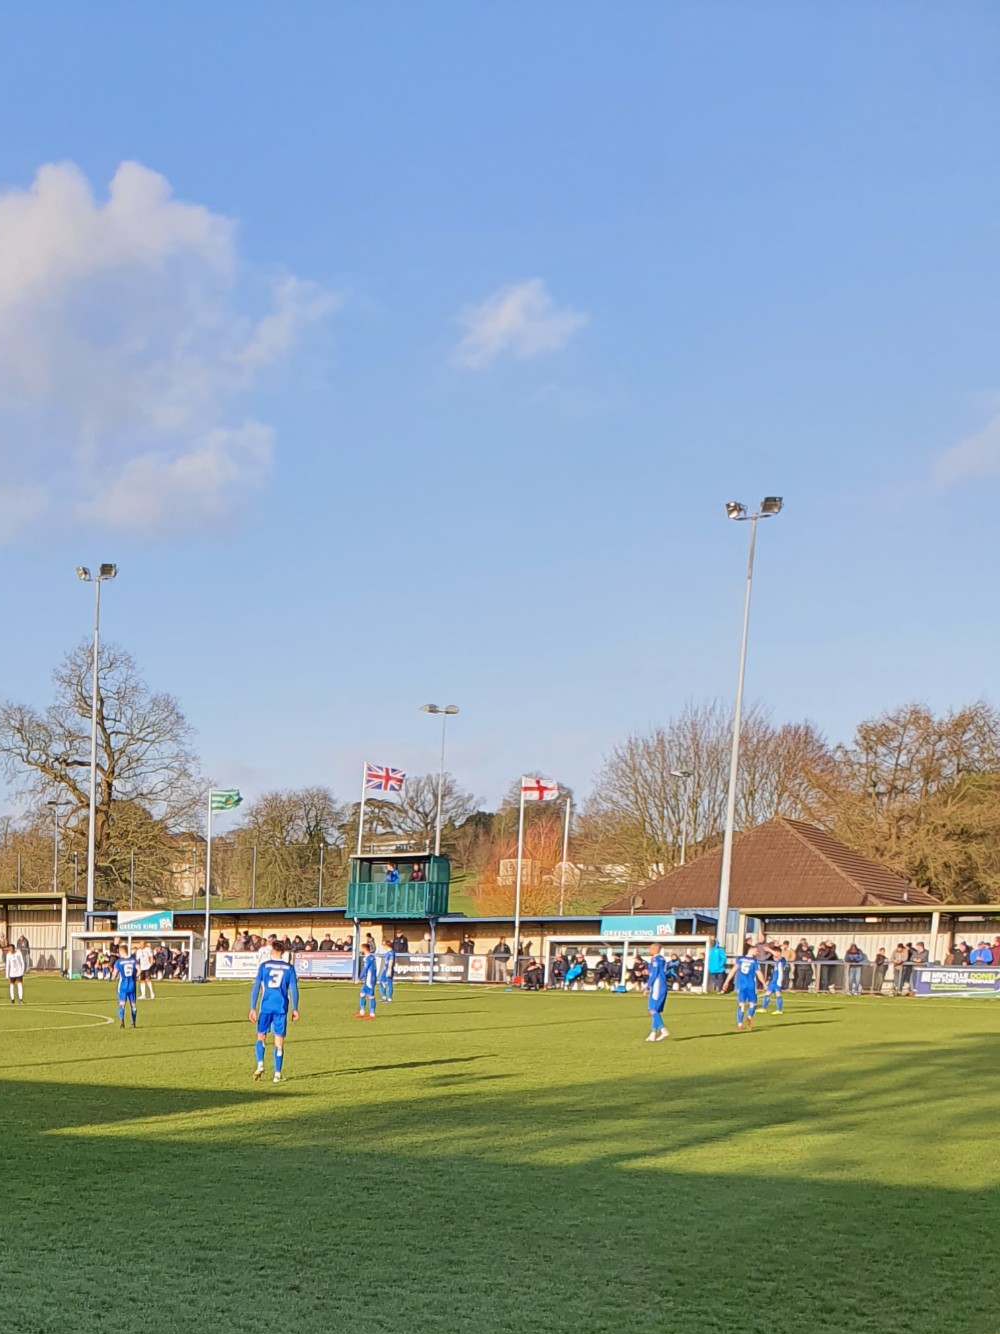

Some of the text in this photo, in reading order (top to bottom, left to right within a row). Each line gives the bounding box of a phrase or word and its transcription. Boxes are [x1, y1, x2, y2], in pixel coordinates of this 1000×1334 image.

[159, 917, 172, 929] IPA
[656, 923, 673, 935] IPA
[124, 963, 134, 977] 6
[393, 963, 464, 973] ippenham Town
[268, 970, 285, 988] 3
